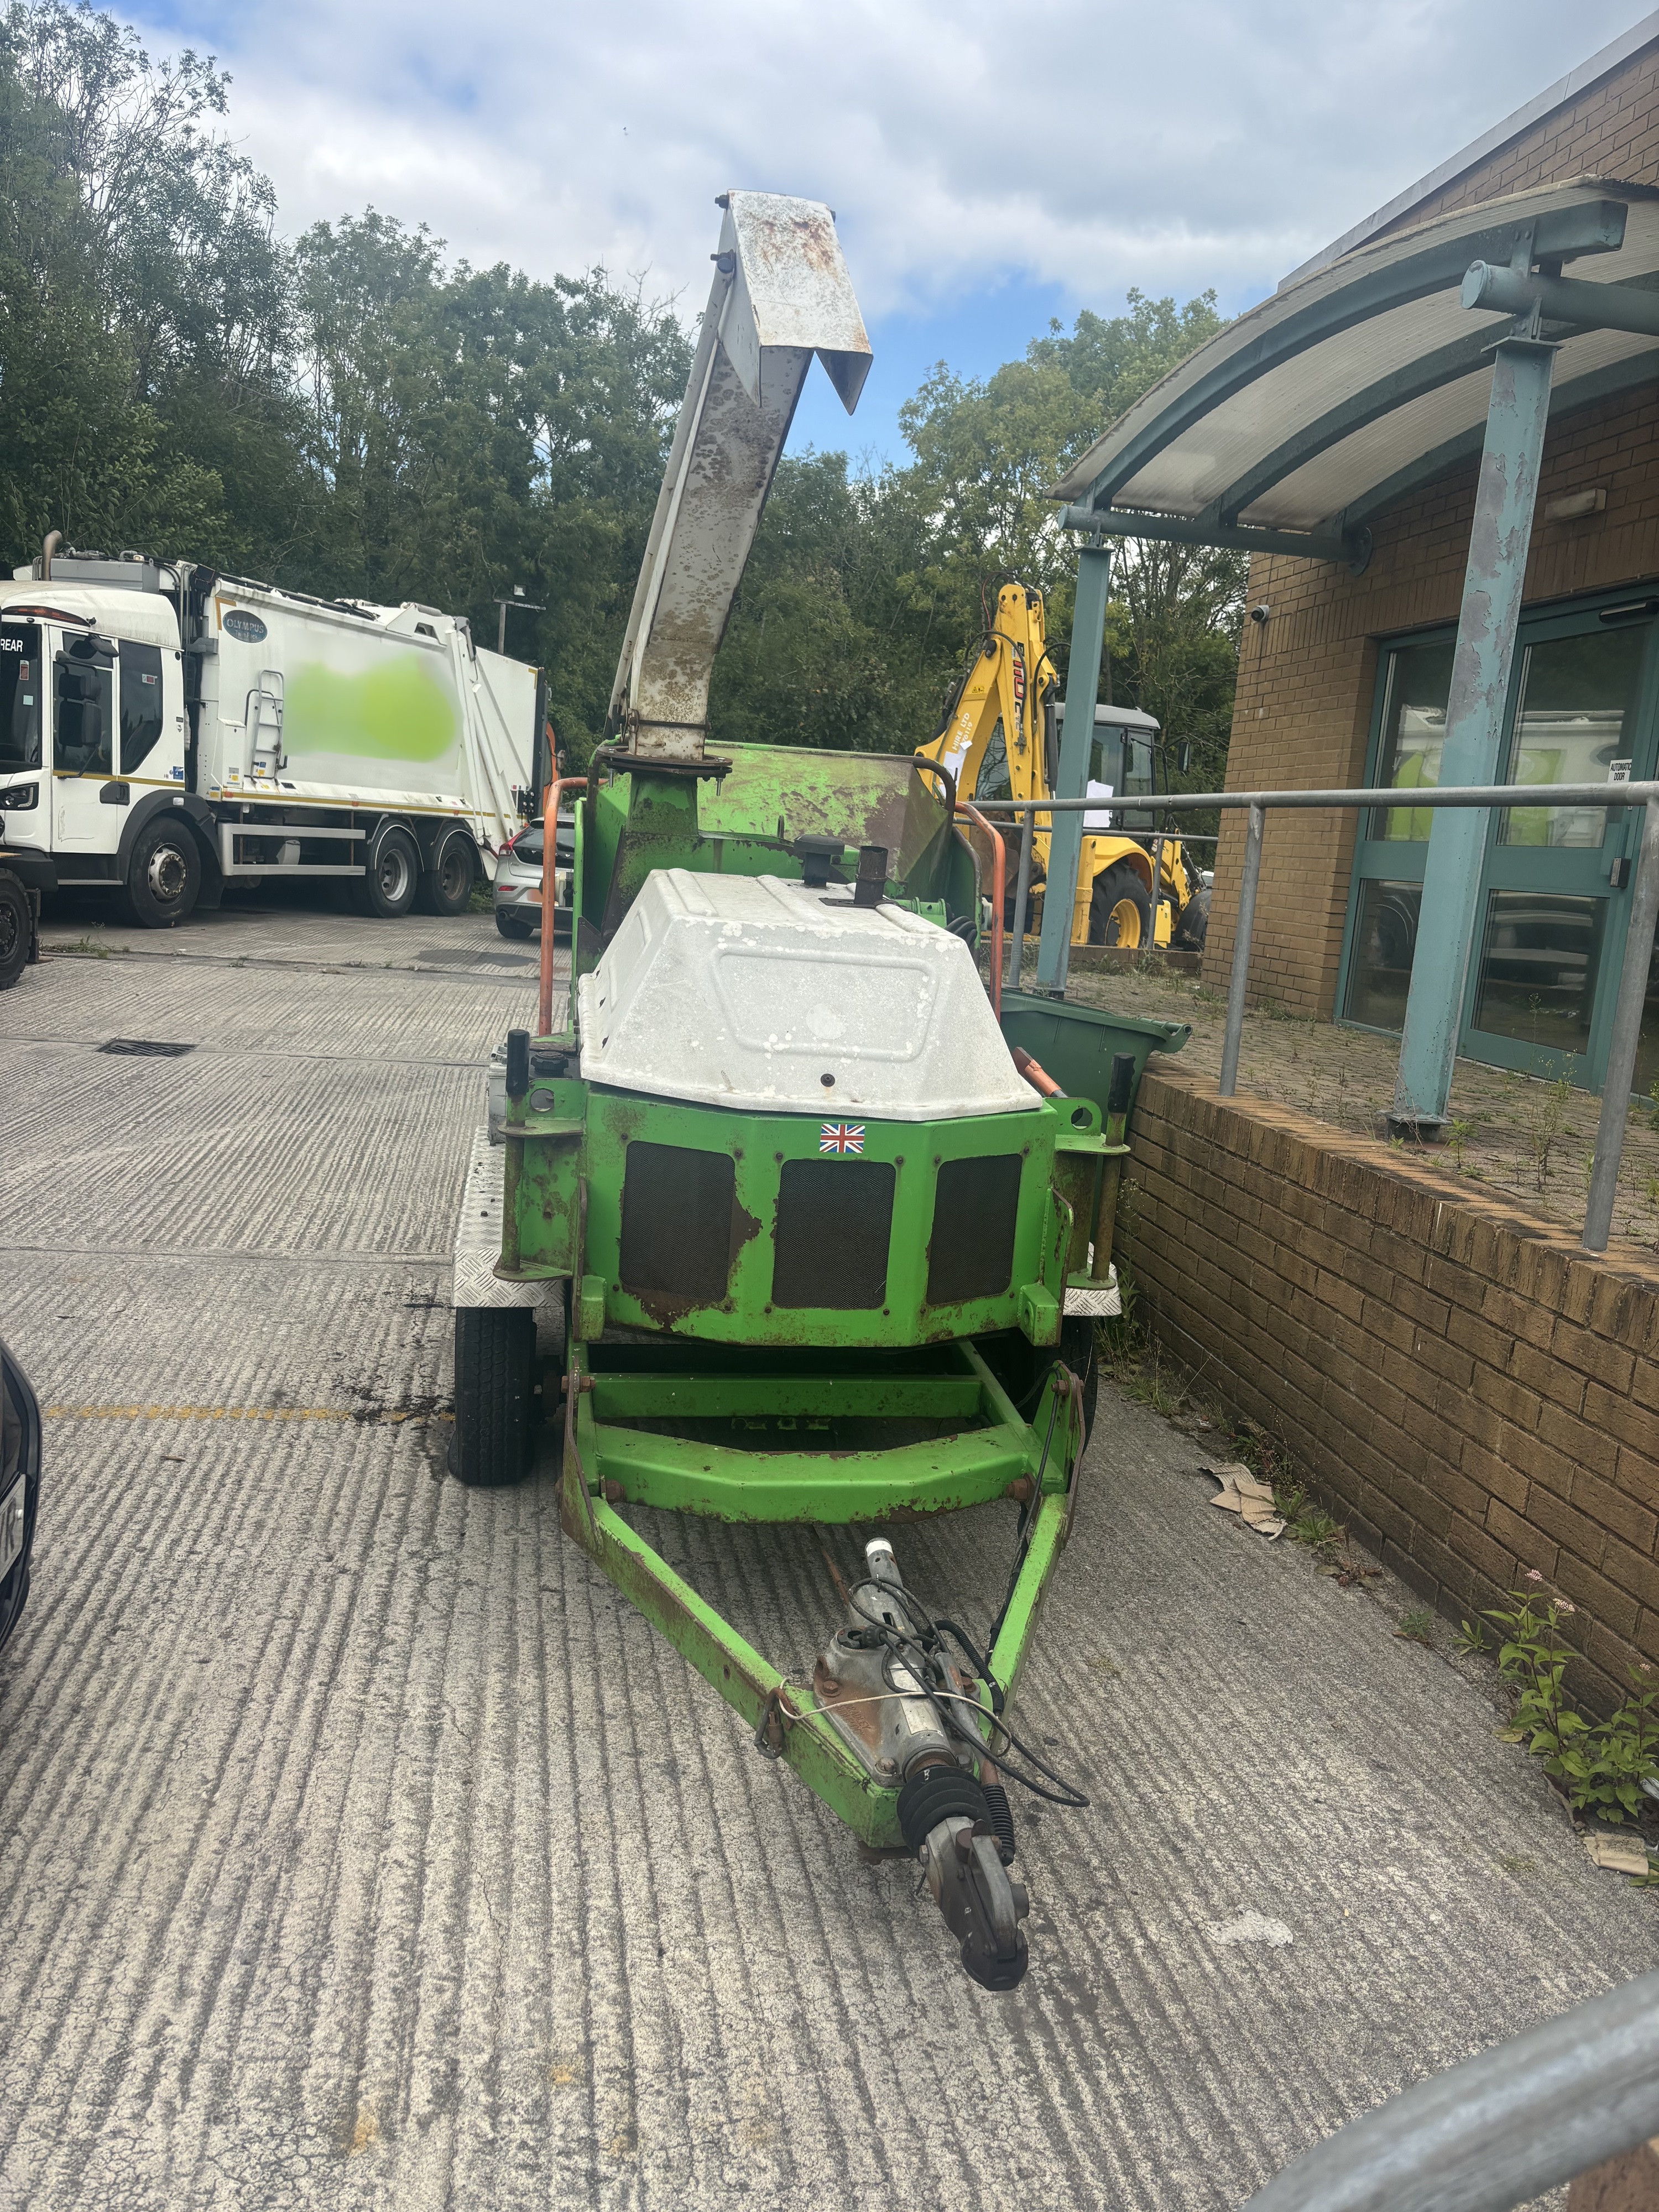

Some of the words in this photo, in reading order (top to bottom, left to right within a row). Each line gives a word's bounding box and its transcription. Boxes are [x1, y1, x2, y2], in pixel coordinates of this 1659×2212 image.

[226, 618, 264, 634] OLYMPUS
[0, 638, 23, 653] REAR
[952, 729, 963, 750] HIRE
[960, 712, 970, 728] LTD
[1610, 763, 1631, 771] AUTOMATIC
[1614, 772, 1625, 781] DOOR
